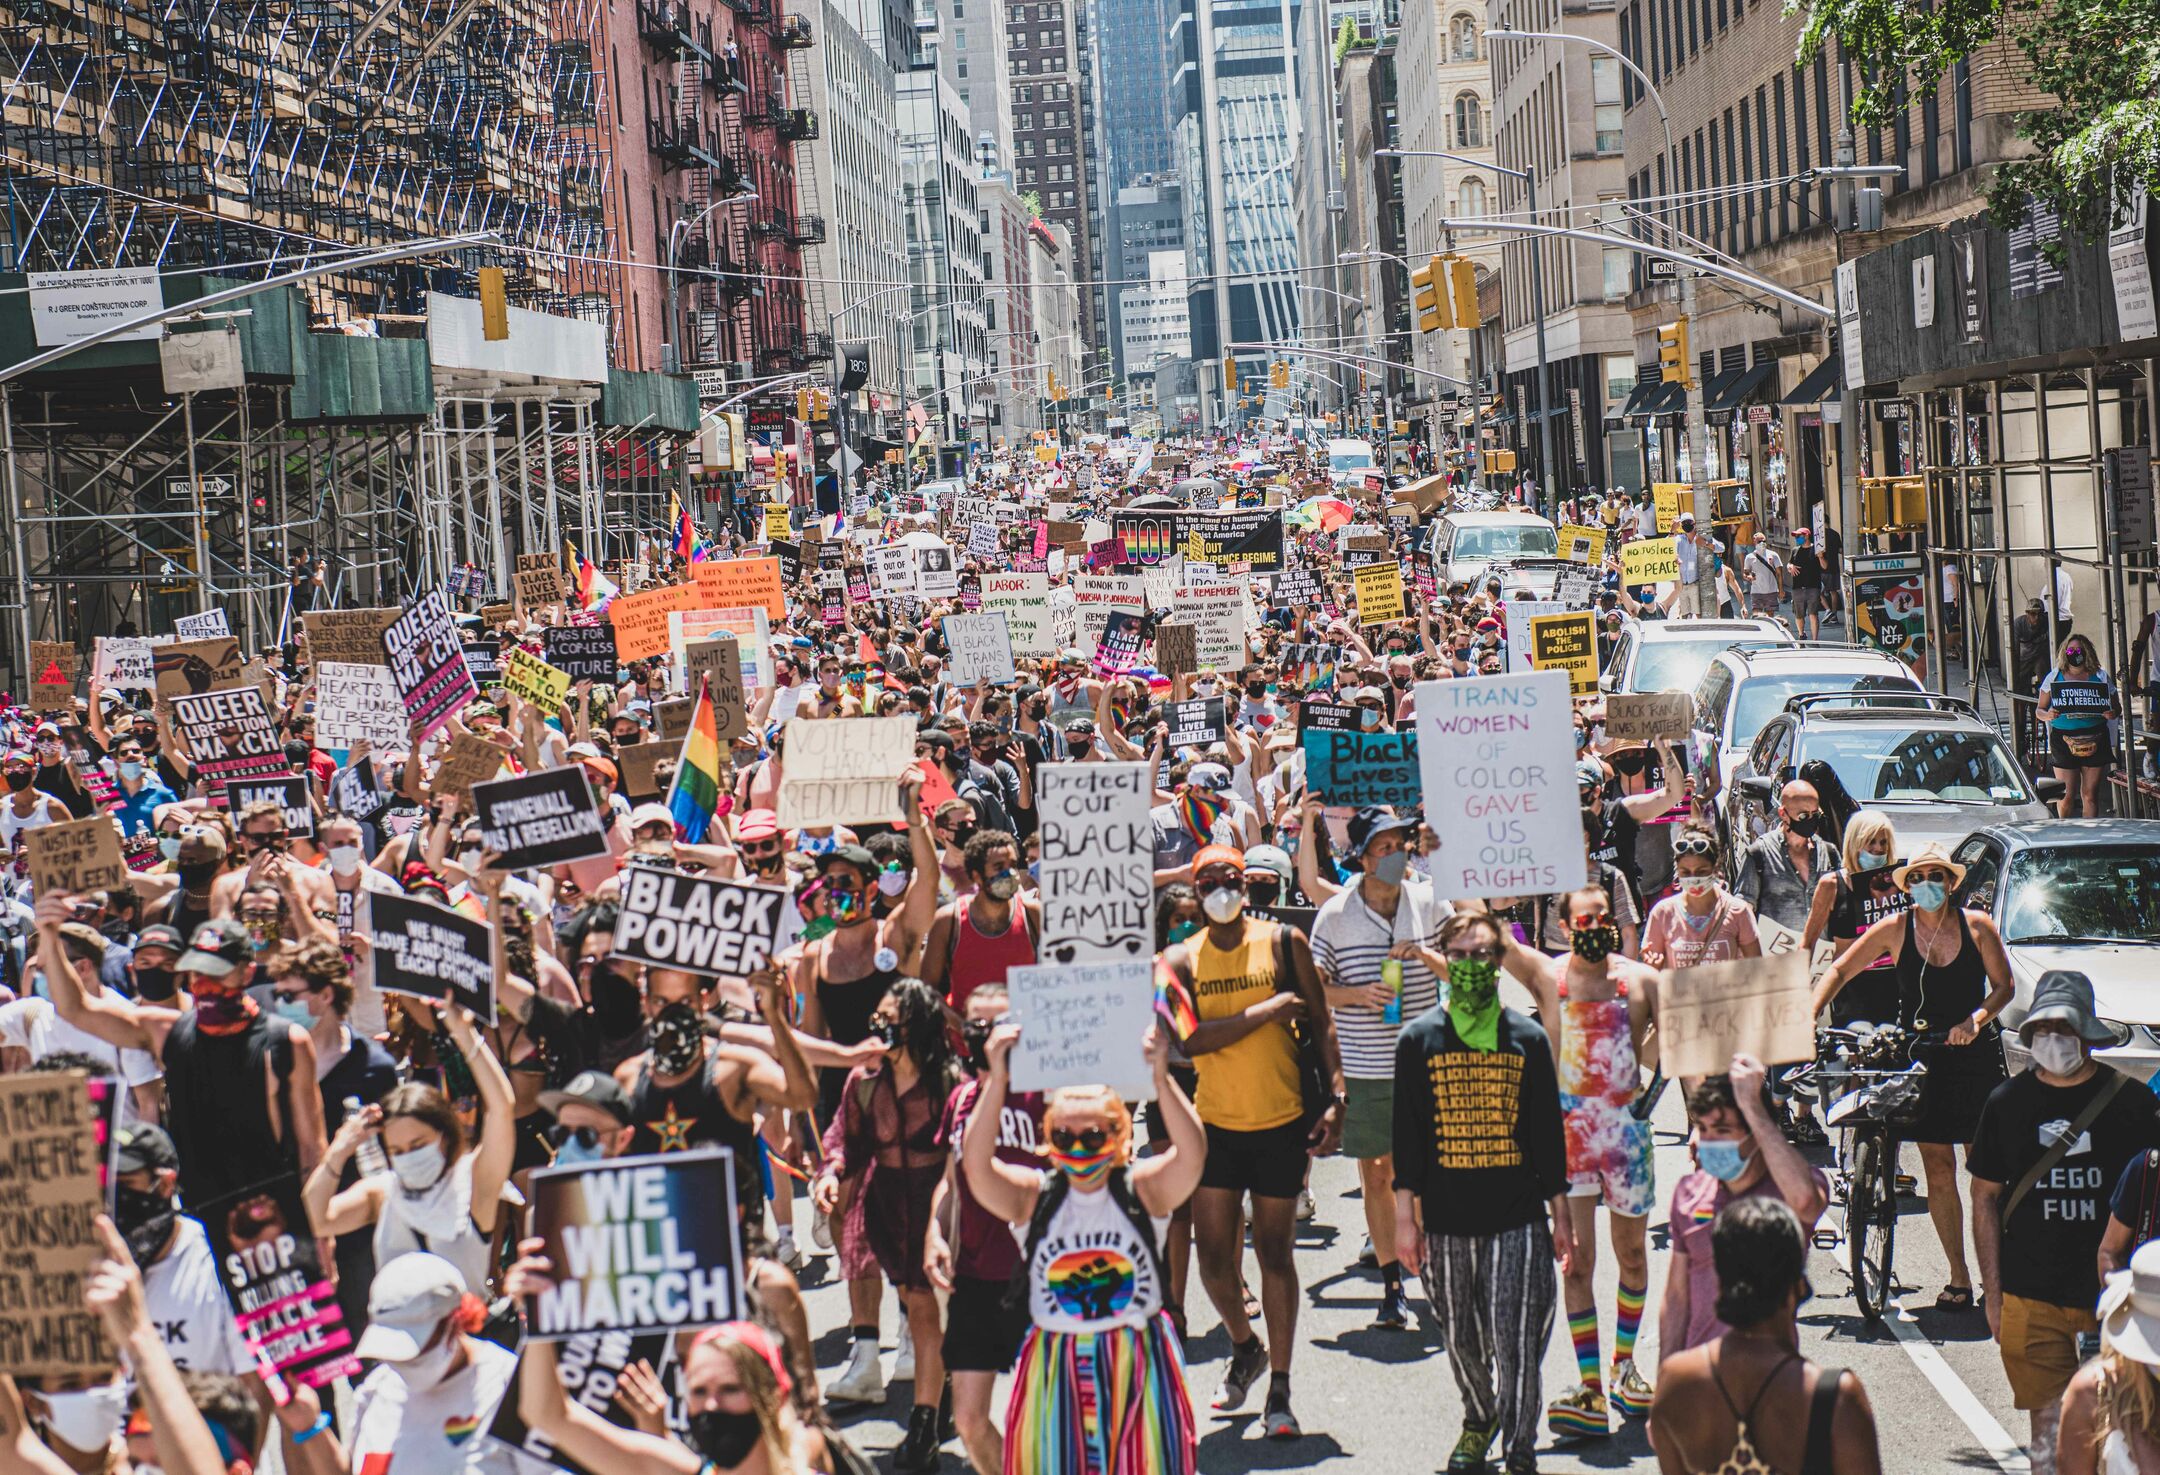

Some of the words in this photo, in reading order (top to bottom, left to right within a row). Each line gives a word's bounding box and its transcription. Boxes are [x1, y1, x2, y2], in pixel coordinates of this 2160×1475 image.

[59, 304, 80, 312] GREEN
[81, 302, 130, 312] CONSTRUCTION
[130, 300, 149, 308] CORP.
[958, 500, 995, 516] BLACK
[1232, 514, 1270, 522] humanity,
[1231, 522, 1258, 532] Accept
[1116, 518, 1171, 565] NO!
[1206, 542, 1222, 554] OUT
[1627, 548, 1639, 556] NO
[1641, 542, 1674, 555] JUSTICE
[884, 550, 902, 559] NYPD
[1242, 552, 1276, 564] REGIME
[1350, 553, 1372, 562] BLACK
[520, 554, 556, 572] BLACK
[884, 562, 896, 570] OUT
[897, 560, 906, 568] OF
[1626, 566, 1640, 575] NO
[1644, 560, 1678, 576] PEACE
[1873, 559, 1904, 570] TITAN
[521, 574, 556, 585] BLACK
[741, 576, 773, 585] CHANGE
[887, 572, 906, 581] PRIDE!
[1280, 574, 1294, 582] WE
[1296, 572, 1310, 580] SEE
[1373, 574, 1395, 582] PRIDE
[524, 584, 557, 596] LIVES
[989, 578, 1030, 592] LABOR:
[1085, 580, 1112, 590] HONOR
[1118, 582, 1128, 590] TO
[1175, 588, 1188, 598] WE
[1194, 586, 1240, 598] REMEMBER
[1274, 588, 1300, 598] BLACK
[1302, 586, 1322, 596] MAN
[1278, 579, 1316, 590] ANOTHER
[522, 594, 562, 606] MATTER
[718, 590, 744, 598] SOCIAL
[748, 588, 775, 597] NORMS
[1375, 594, 1395, 602] PRIDE
[984, 598, 1017, 609] DEFEND
[1372, 602, 1398, 610] PRISON
[384, 590, 445, 655] QUEER
[954, 616, 995, 633] DYKES
[1882, 624, 1897, 634] NY
[550, 630, 580, 642] FAGS
[582, 628, 604, 640] FOR
[1110, 630, 1140, 644] BLACK
[1156, 625, 1196, 638] BLACK
[1542, 626, 1586, 639] ABOLISH
[559, 642, 614, 654] COP-LESS
[964, 634, 998, 649] BLACK
[1108, 639, 1137, 652] TRANS
[1160, 638, 1196, 650] TRANS
[1546, 643, 1582, 654] POLICE!
[1555, 637, 1572, 646] THE
[690, 648, 727, 666] WHITE
[966, 650, 1005, 664] TRANS
[1104, 648, 1134, 662] LIVES
[1160, 650, 1195, 662] LIVES
[116, 656, 150, 670] TONY
[513, 650, 554, 680] BLACK
[212, 668, 240, 682] BLM
[319, 664, 376, 679] LISTEN
[963, 666, 1002, 680] LIVES
[319, 679, 383, 698] HEARTS
[2061, 688, 2100, 698] STONEWALL
[320, 696, 347, 709] ARE
[1450, 686, 1538, 708] TRANS
[2052, 697, 2066, 706] WAS
[2074, 696, 2110, 706] REBELLION
[176, 691, 265, 725] QUEER
[1177, 701, 1206, 714] BLACK
[1309, 706, 1352, 718] SOMEONE
[1608, 702, 1645, 720] BLACK
[1177, 711, 1206, 722] TRANS
[1318, 716, 1340, 726] ONCE
[318, 723, 350, 736] LET
[359, 725, 400, 739] THEM
[1178, 720, 1205, 731] LIVES
[1436, 714, 1530, 736] WOMEN
[1606, 720, 1636, 734] LIVES
[792, 724, 854, 755] VOTE
[868, 722, 912, 750] FOR
[1172, 729, 1215, 742] MATTER
[1330, 733, 1419, 764] Black
[1476, 740, 1508, 762] OF
[204, 772, 227, 780] AND
[232, 764, 284, 776] AGAINST
[822, 752, 888, 780] HARM
[1330, 762, 1410, 786] Lives
[1454, 766, 1548, 789] COLOR
[784, 781, 902, 821] REDUCTIO
[1318, 785, 1416, 806] Matter
[490, 790, 574, 827] STONEWALL
[1465, 793, 1540, 818] GAVE
[521, 809, 600, 847] REBELLION
[1488, 820, 1526, 844] US
[36, 826, 98, 853] JUSTICE
[1042, 822, 1152, 860] BLACK
[1479, 846, 1536, 866] OUR
[1044, 864, 1150, 899] TRANS
[1462, 866, 1557, 889] RIGHTS
[628, 871, 766, 935] BLACK
[1864, 892, 1908, 911] BLACK
[1044, 899, 1150, 934] FAMILY
[406, 920, 431, 939] WE
[434, 925, 466, 950] MUST
[616, 912, 771, 974] POWER
[373, 928, 409, 952] LOVE
[439, 943, 492, 984] SUPPORT
[395, 953, 432, 975] EACH
[1018, 970, 1070, 994] Black
[1032, 996, 1096, 1018] Deserve
[1106, 994, 1124, 1007] to
[1043, 1012, 1107, 1034] Thrive!
[1664, 1009, 1739, 1048] BLACK
[1039, 1051, 1100, 1073] Matter
[580, 1166, 668, 1222] WE
[2044, 1200, 2096, 1220] FUN
[562, 1218, 696, 1280] WILL
[226, 1234, 296, 1288] STOP
[237, 1270, 307, 1312] KILLING
[537, 1266, 732, 1334] MARCH
[246, 1296, 319, 1344] BLACK
